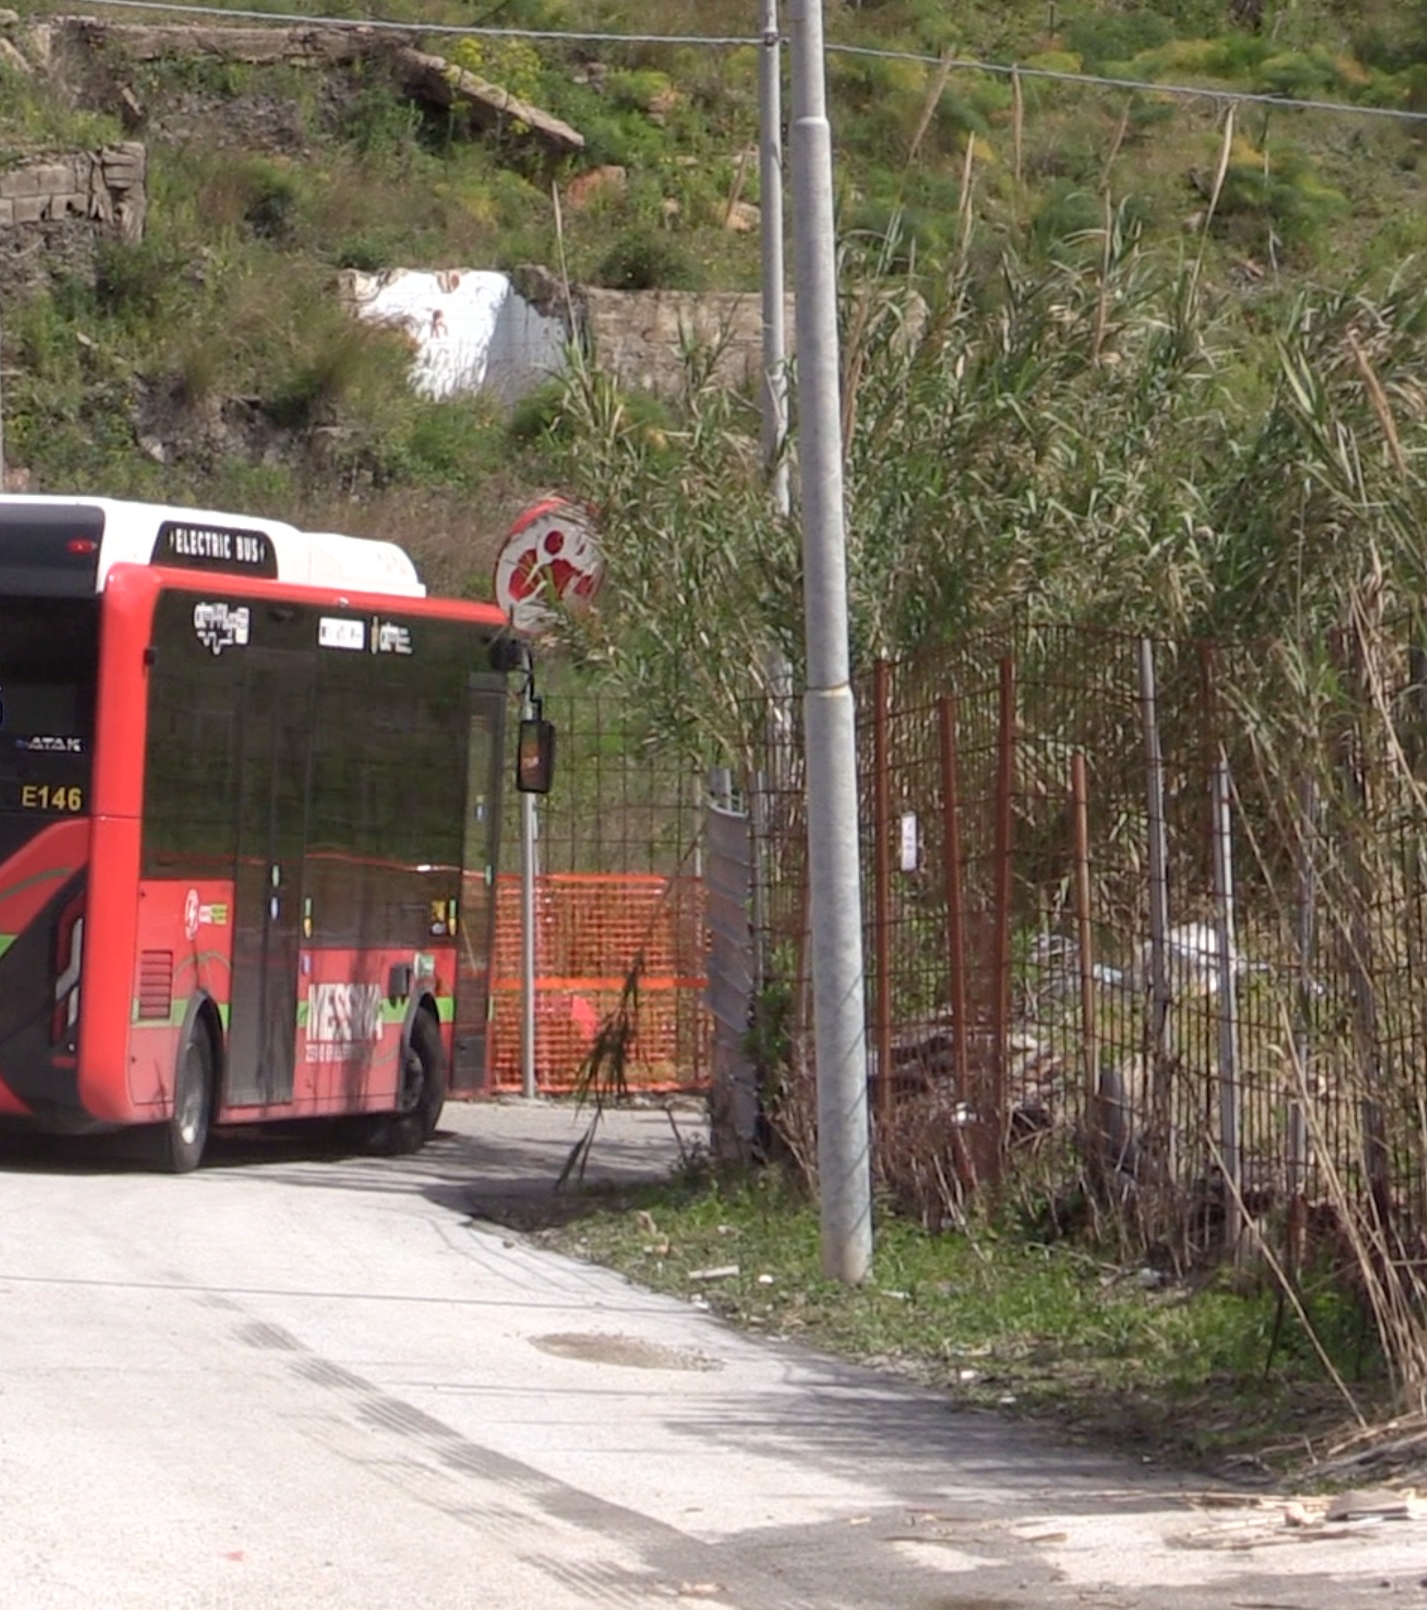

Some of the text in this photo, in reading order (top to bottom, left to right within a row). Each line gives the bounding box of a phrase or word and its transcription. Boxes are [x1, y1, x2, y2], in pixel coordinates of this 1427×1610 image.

[176, 528, 259, 563] ELECTRIC BUS
[22, 785, 82, 811] E146
